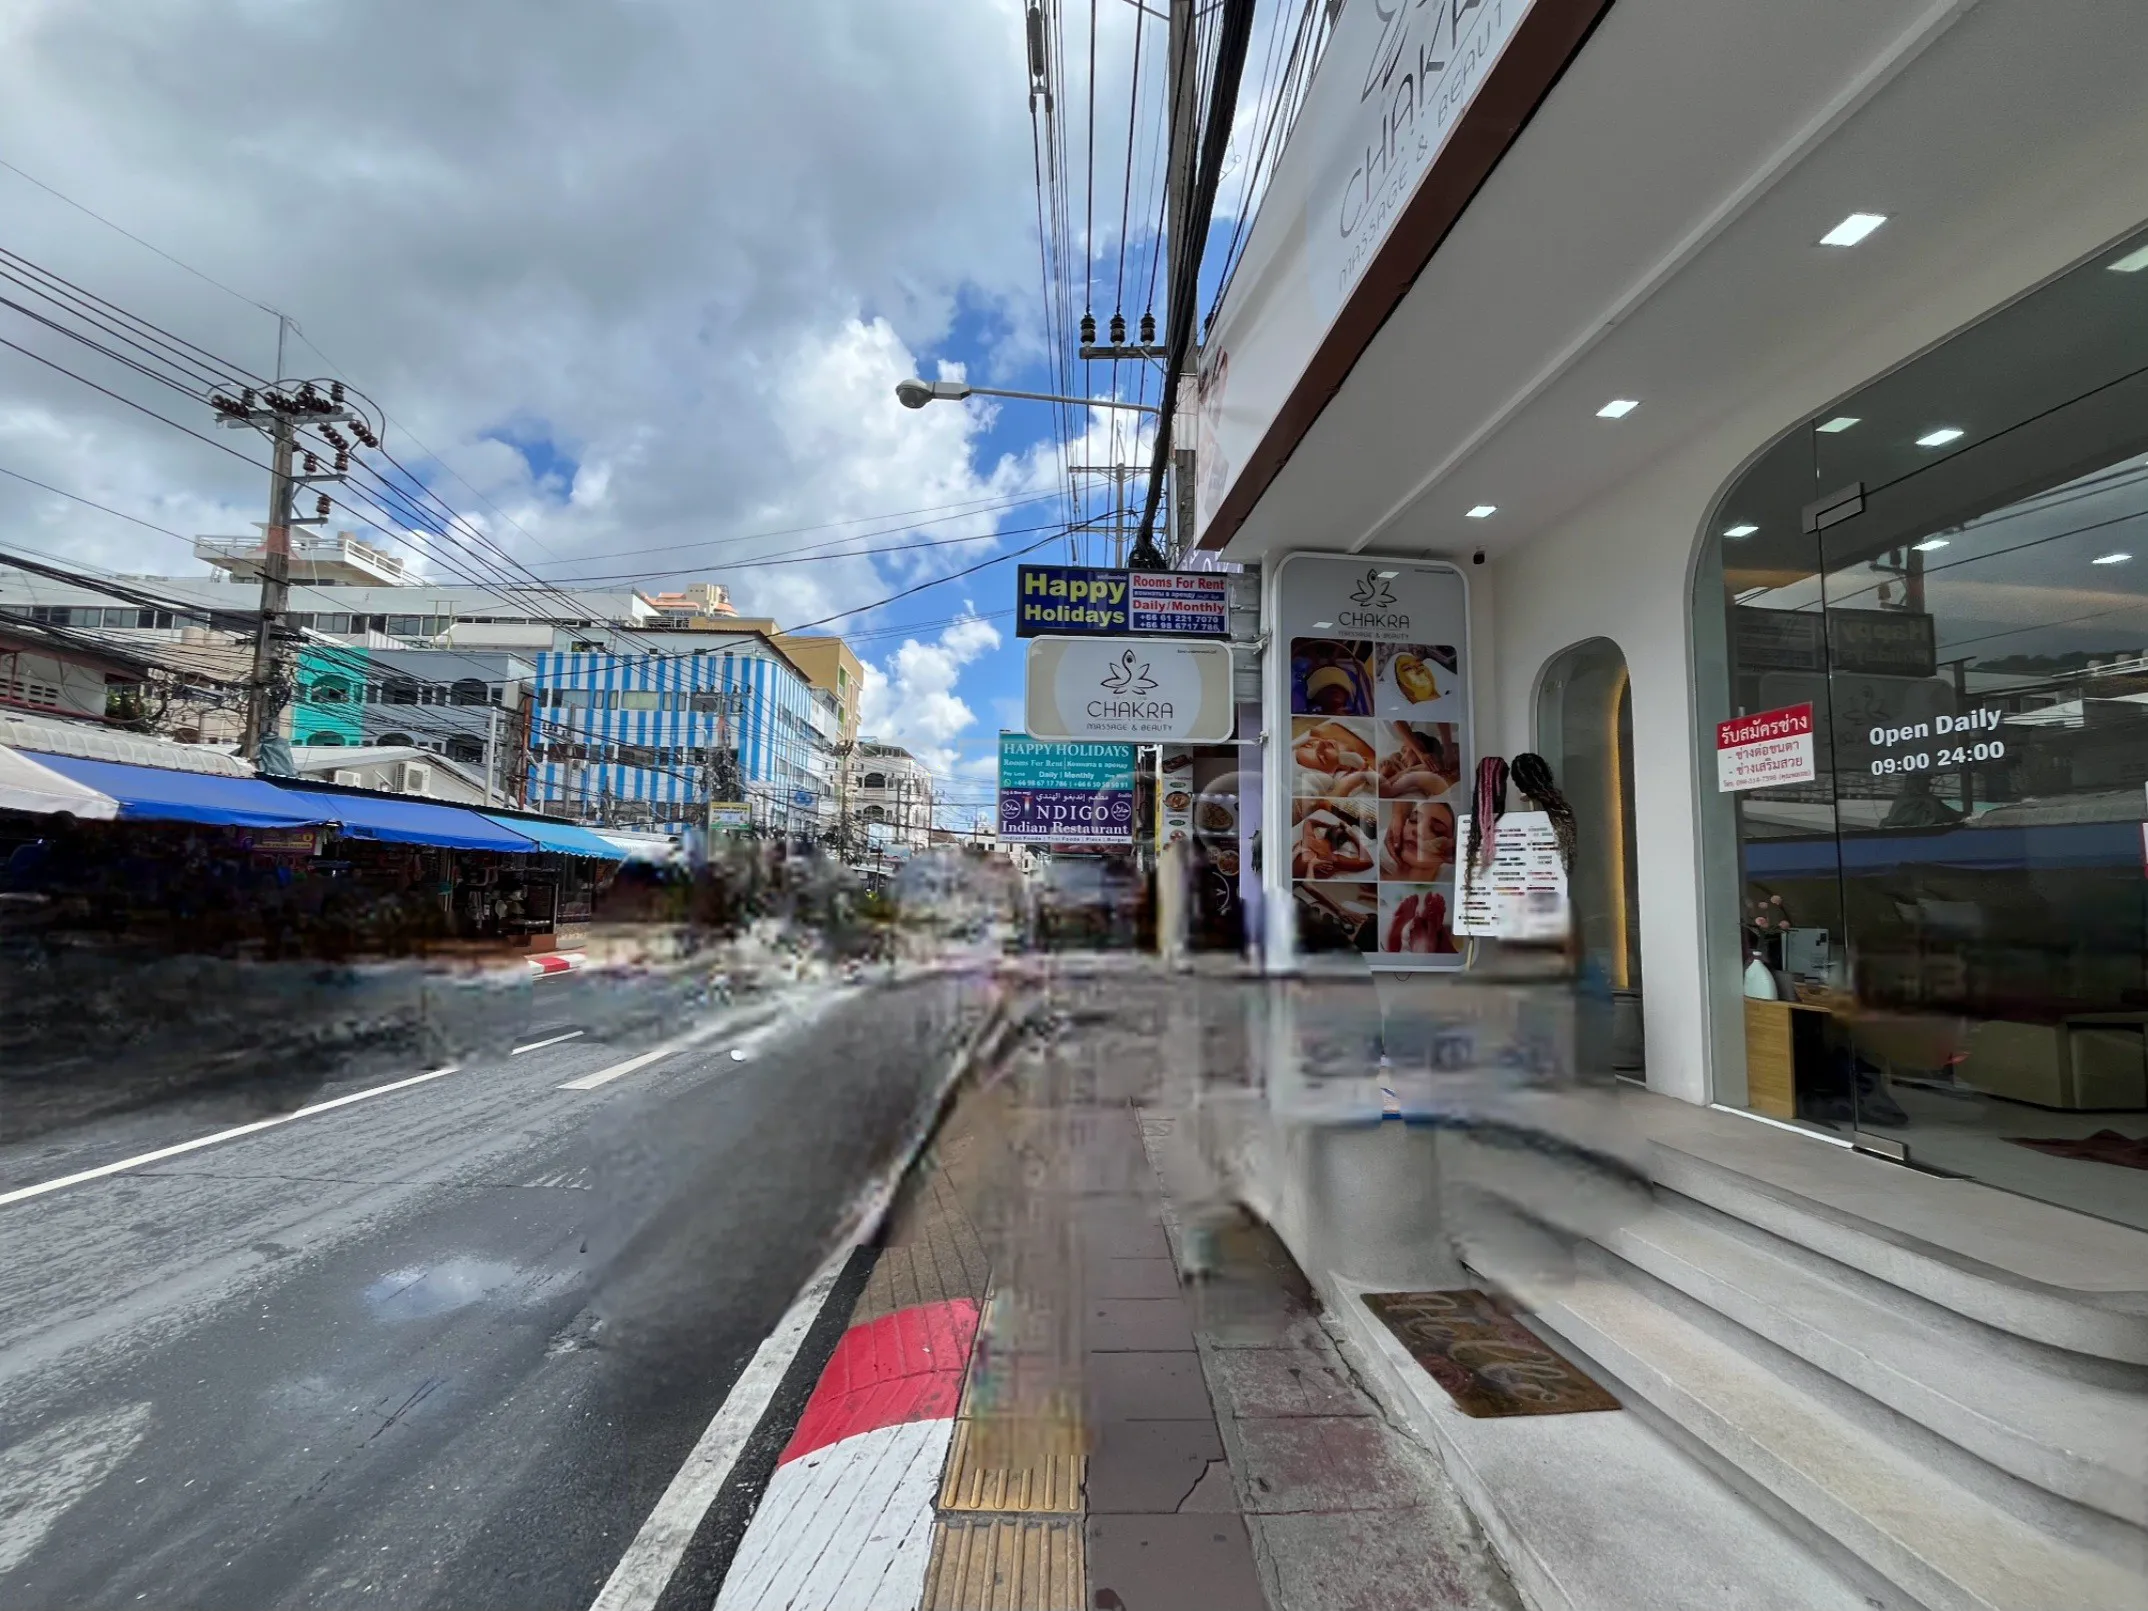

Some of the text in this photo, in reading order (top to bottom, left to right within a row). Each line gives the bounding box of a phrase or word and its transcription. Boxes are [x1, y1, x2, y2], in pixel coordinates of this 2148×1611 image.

[1339, 160, 1408, 292] MASSAGE
[1416, 134, 1428, 163] &
[1024, 573, 1126, 604] Happy
[1133, 575, 1172, 588] Rooms
[1176, 577, 1195, 589] For
[1198, 578, 1225, 590] Rent
[1133, 600, 1225, 614] Daily/Monthly
[1024, 604, 1125, 627] Holidays
[1339, 612, 1410, 628] CHAKRA
[1087, 700, 1174, 719] CHAKRA
[1087, 723, 1127, 731] MASSAGE
[1721, 713, 1808, 744] รับสมัครช่าง
[1869, 708, 2002, 747] Open Daily
[1003, 743, 1130, 757] HAPPY HOLIDAYS
[1003, 759, 1028, 767] Rooms
[1871, 741, 2005, 776] 09:00 24:00
[1039, 771, 1058, 779] Daily
[1064, 771, 1095, 780] Monthly
[1002, 820, 1129, 835] Indian Restaurant
